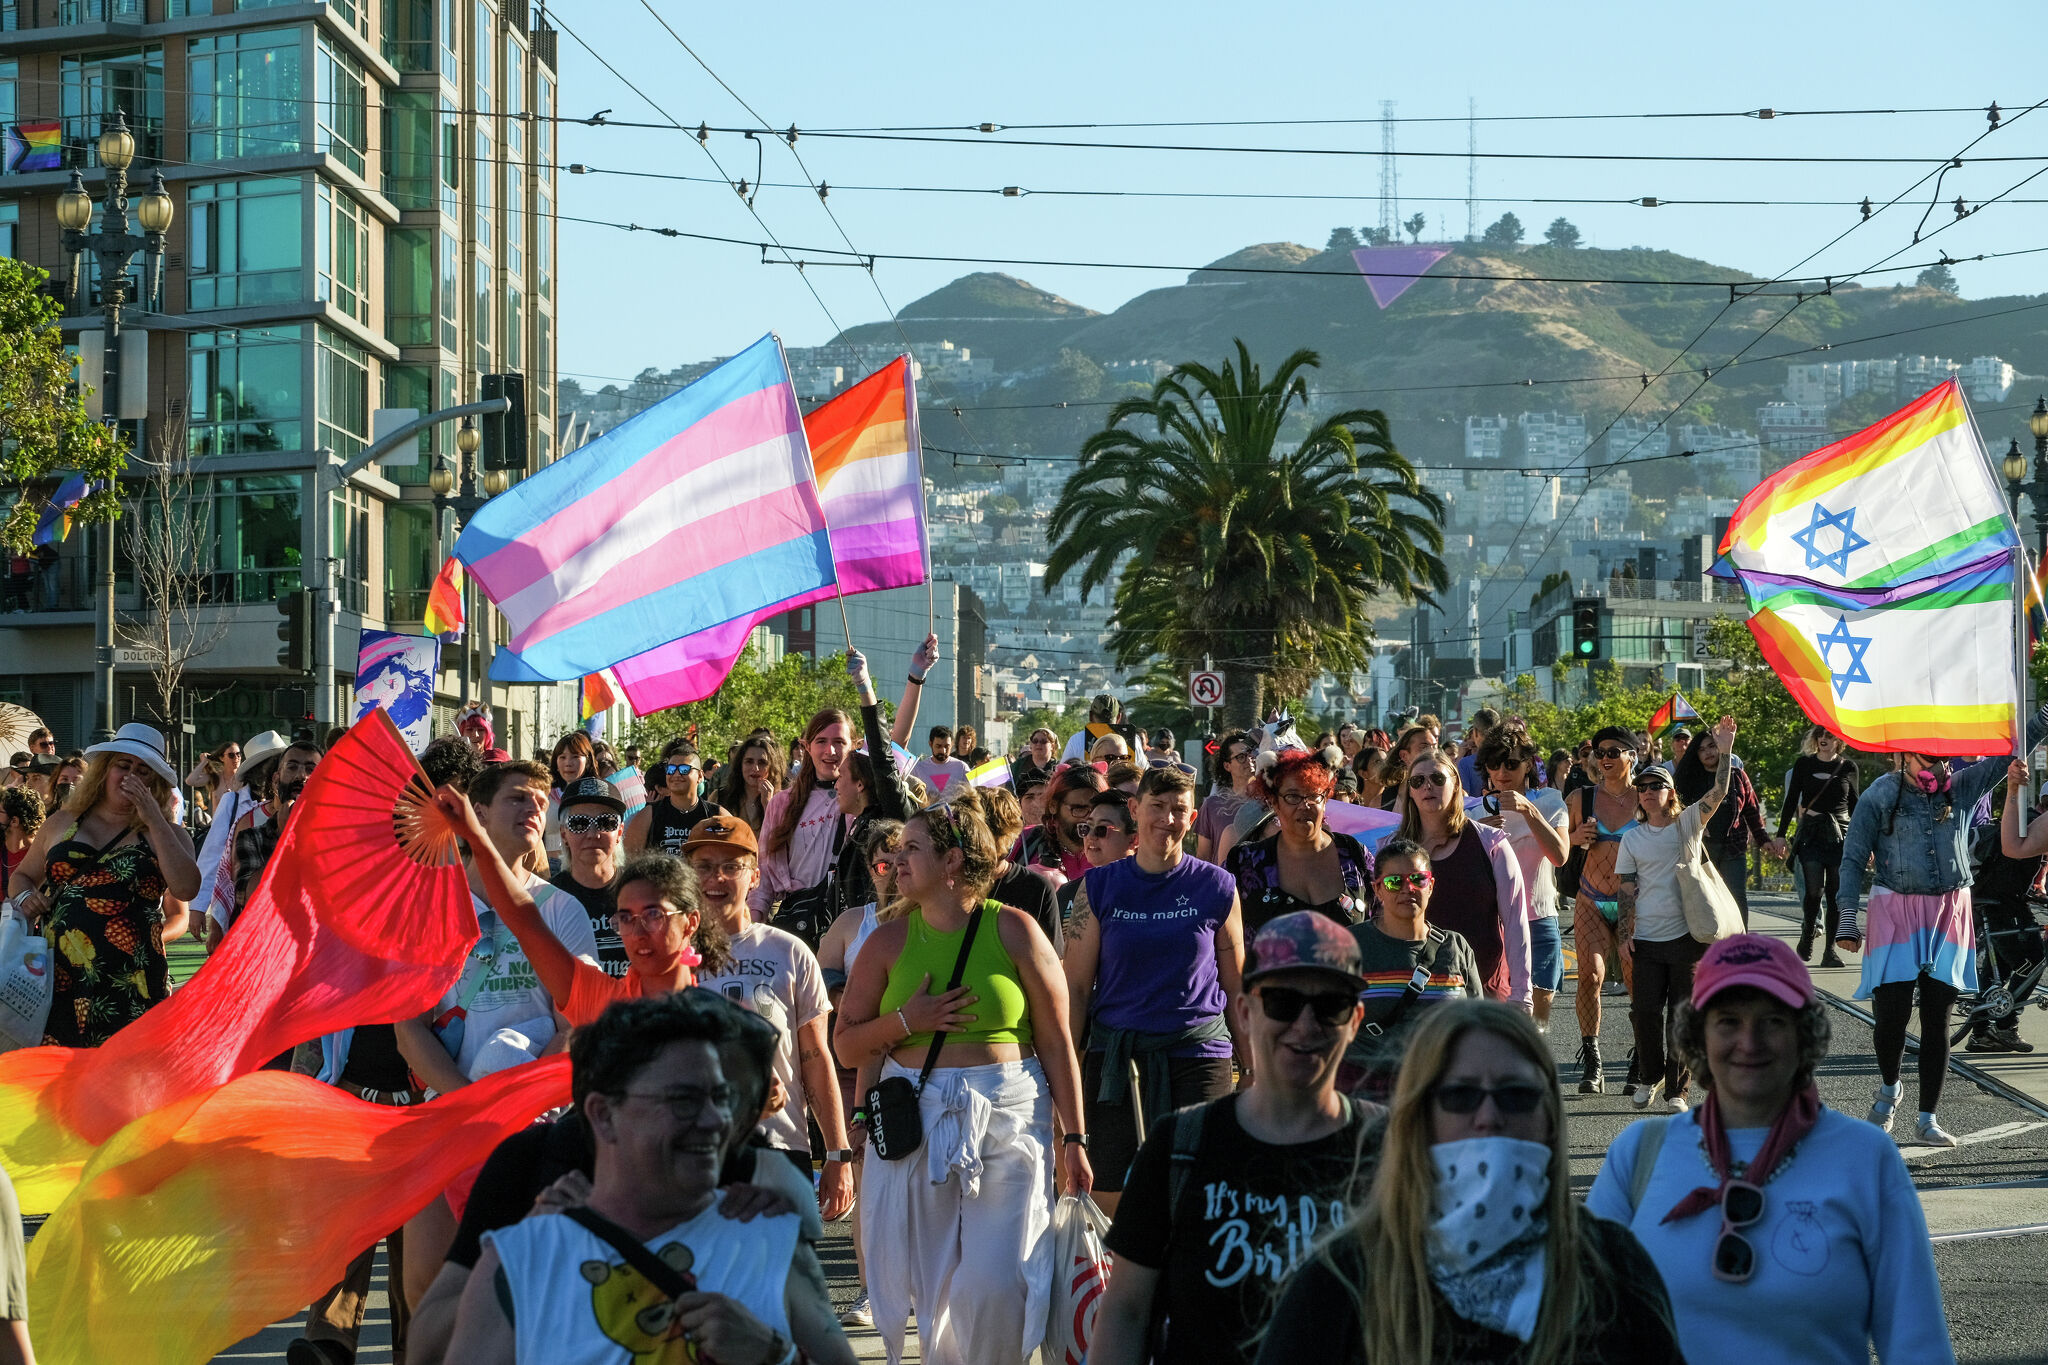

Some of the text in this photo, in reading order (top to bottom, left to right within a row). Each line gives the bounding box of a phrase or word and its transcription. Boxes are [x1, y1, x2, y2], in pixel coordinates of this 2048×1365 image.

[123, 651, 168, 661] DOLORE
[664, 826, 691, 838] Prot
[1152, 907, 1198, 920] march
[509, 961, 534, 975] NO
[1204, 1180, 1288, 1227] It's my
